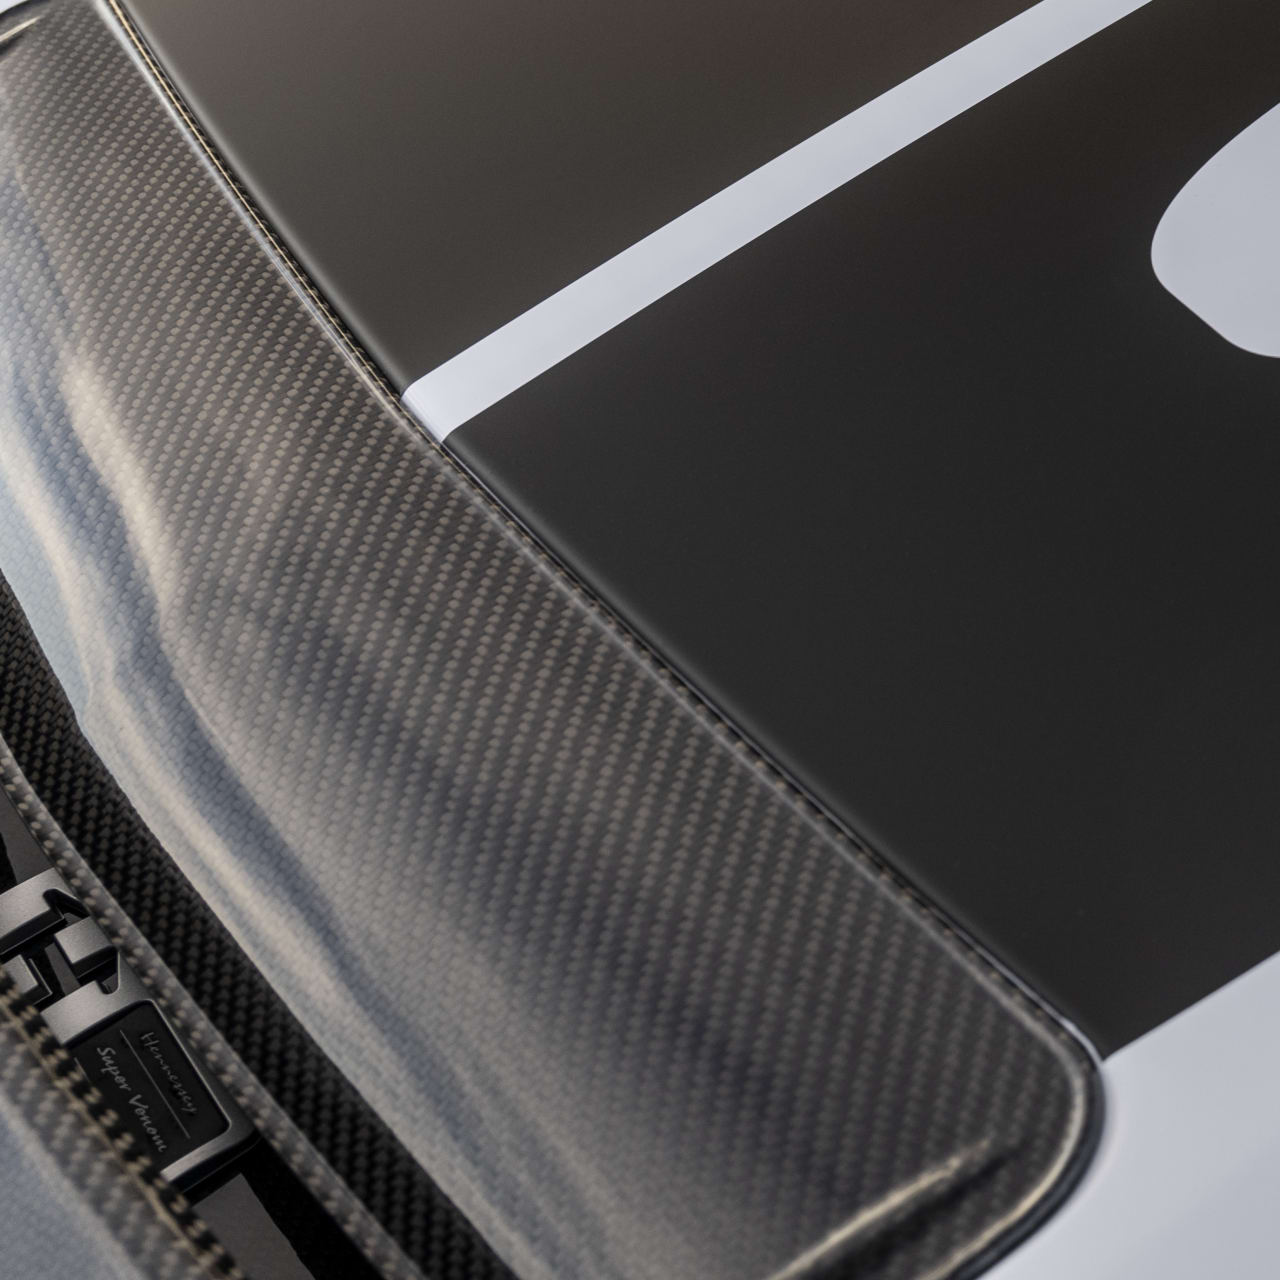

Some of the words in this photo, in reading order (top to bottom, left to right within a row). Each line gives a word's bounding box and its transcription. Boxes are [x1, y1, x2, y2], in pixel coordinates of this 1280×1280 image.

[97, 1047, 132, 1091] Super
[128, 1094, 167, 1153] Venom
[141, 1031, 197, 1112] Hennessey
